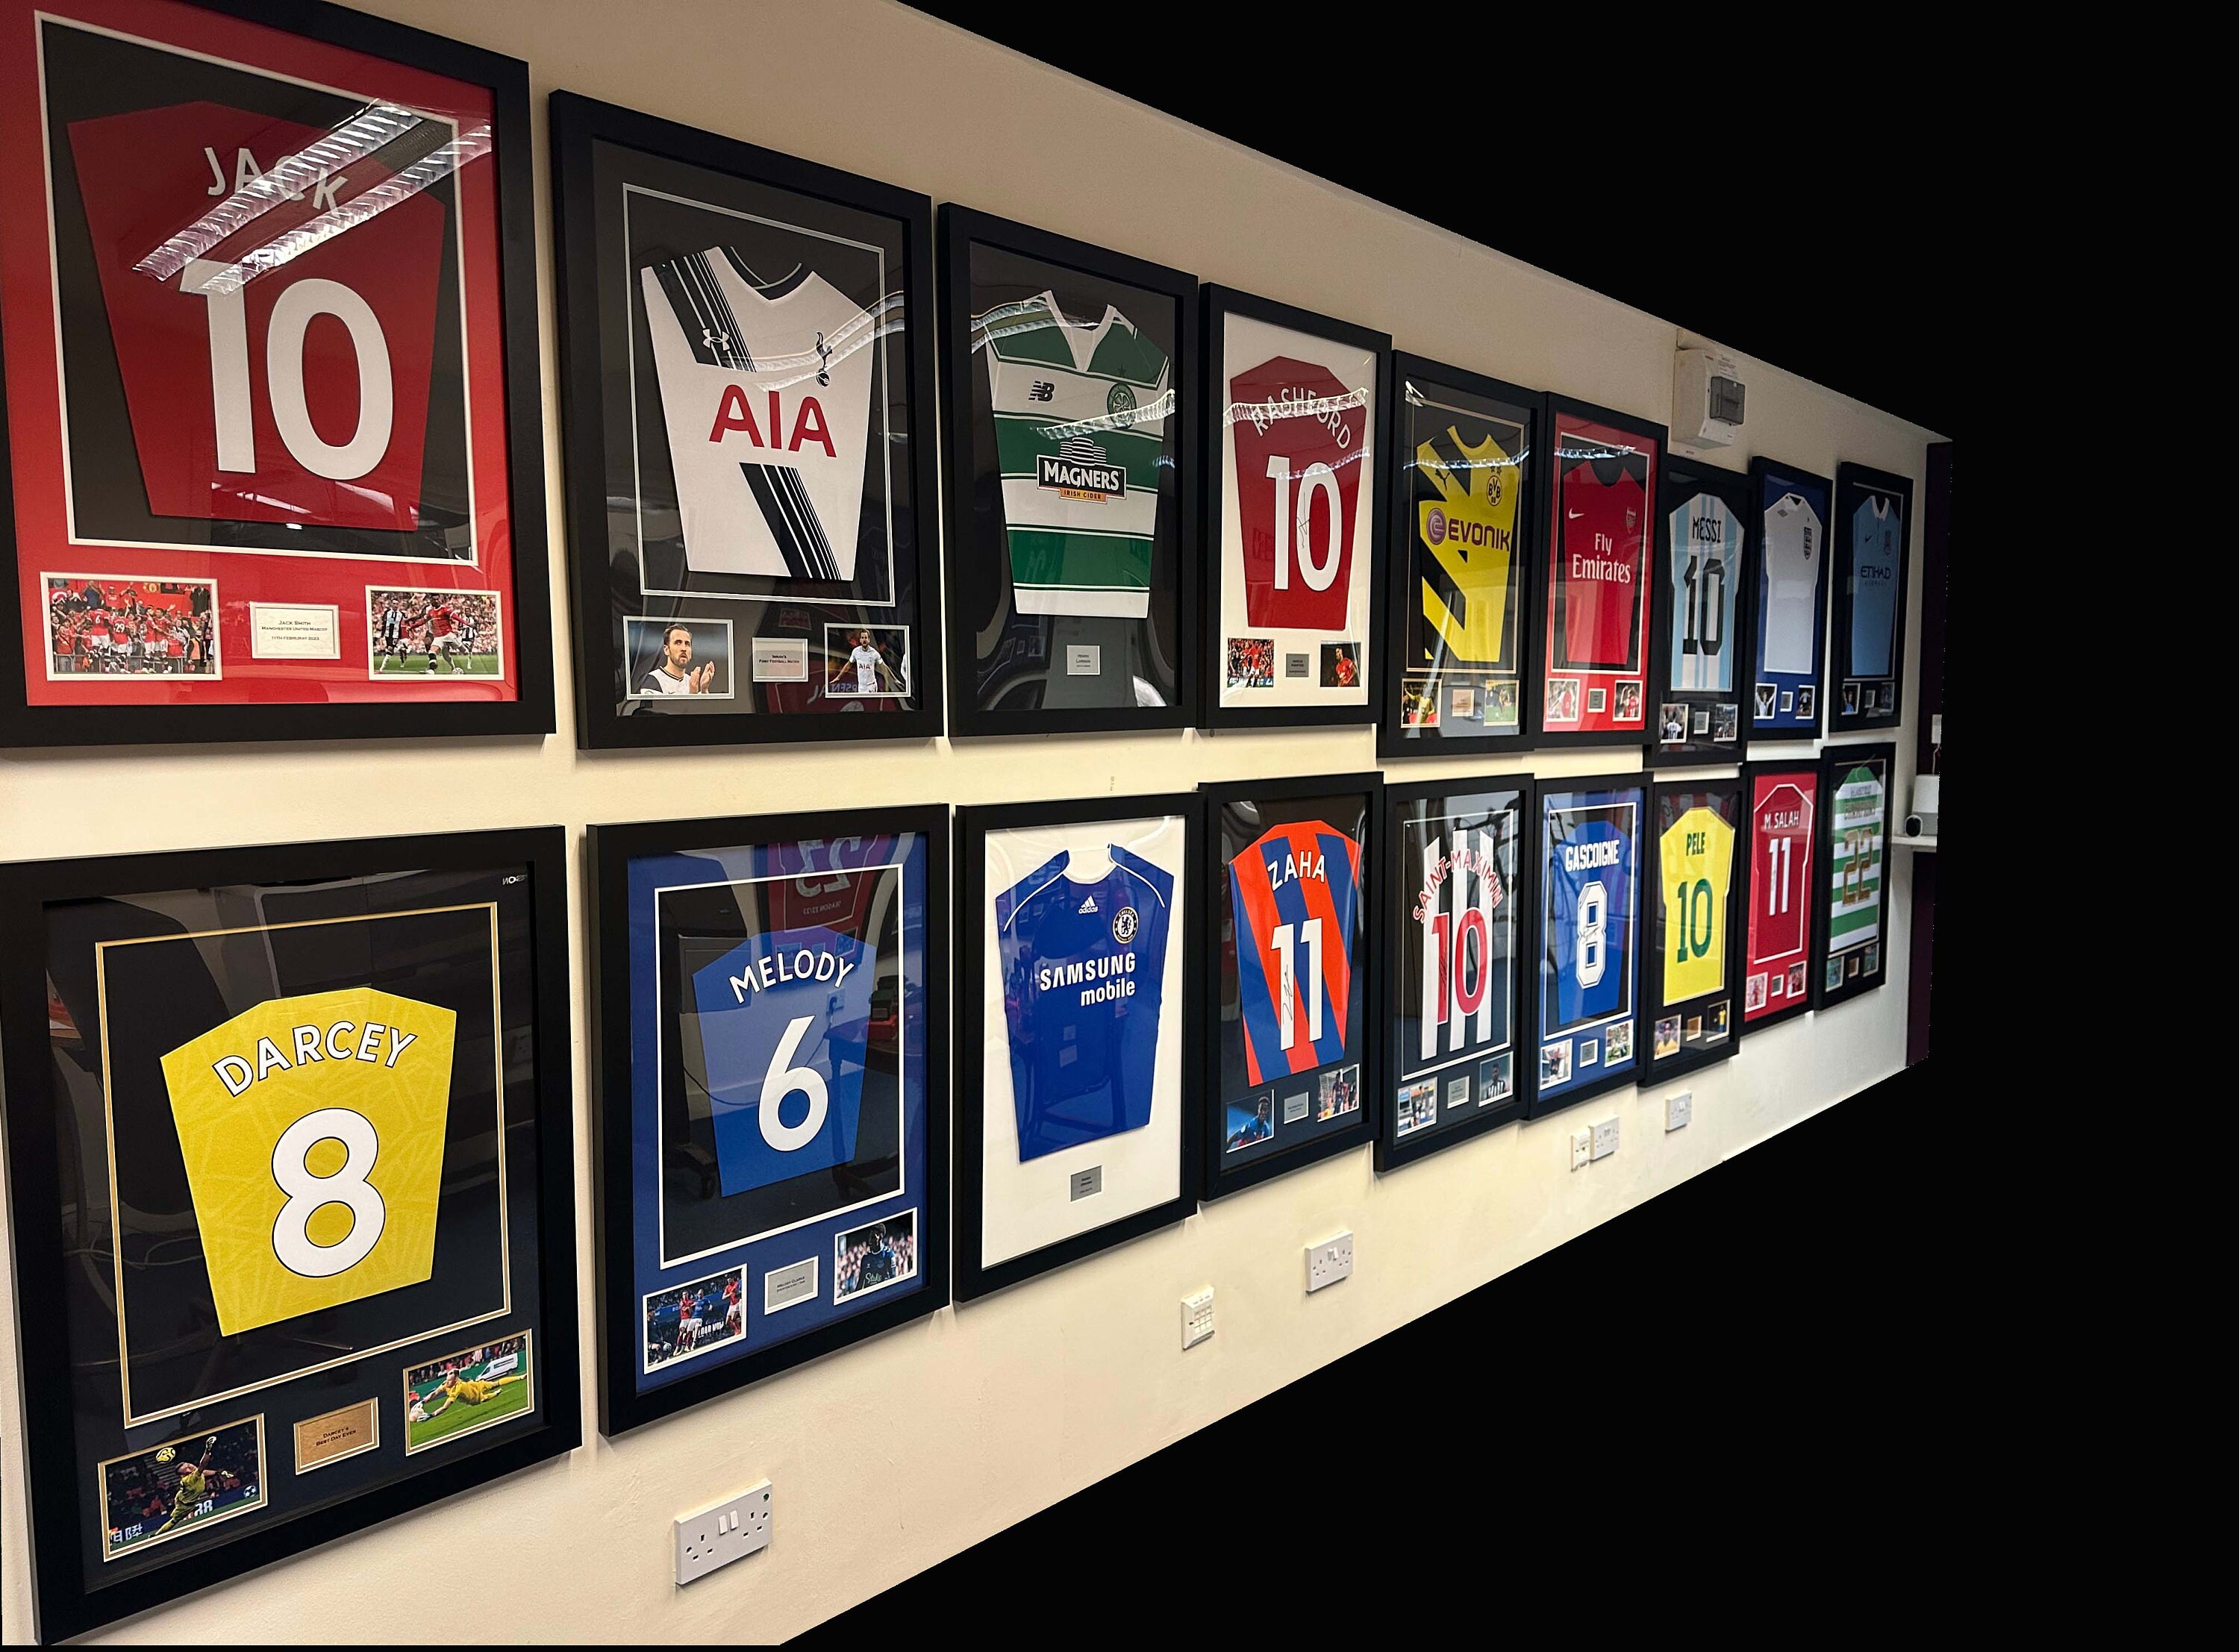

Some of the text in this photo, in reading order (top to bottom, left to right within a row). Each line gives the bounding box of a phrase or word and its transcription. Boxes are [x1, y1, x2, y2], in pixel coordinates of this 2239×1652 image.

[204, 147, 350, 218] JACK
[179, 257, 394, 480] 10
[709, 384, 837, 458] AIA
[1251, 387, 1351, 448] RASHFORD
[1044, 460, 1120, 491] MAGNERS
[1064, 489, 1081, 498] IRISH
[1266, 454, 1342, 592] 10
[1449, 518, 1511, 552] EVONIK
[1595, 533, 1612, 556] Fly
[1692, 516, 1721, 543] MESSI
[1573, 553, 1631, 583] Emirates
[1861, 566, 1891, 579] ETIHAD
[1682, 555, 1725, 655] 10
[1686, 831, 1706, 857] PELE
[1774, 810, 1799, 829] SALAH
[1267, 850, 1325, 892] ZAHA
[1565, 839, 1620, 872] GASCOIGNE
[1769, 836, 1791, 916] 11
[1078, 906, 1099, 914] adidas
[1413, 848, 1503, 924] SAINT-MAXIMIN
[1576, 880, 1608, 989] 8
[1677, 878, 1713, 963] 10
[728, 949, 855, 1004] MELODY
[1040, 952, 1136, 991] SAMSUNG
[1081, 977, 1136, 1007] mobile
[1271, 917, 1323, 1051] 11
[1431, 907, 1488, 1025] 10
[212, 1021, 418, 1098] DARCEY
[758, 1015, 828, 1152] 6
[271, 1107, 386, 1278] 8
